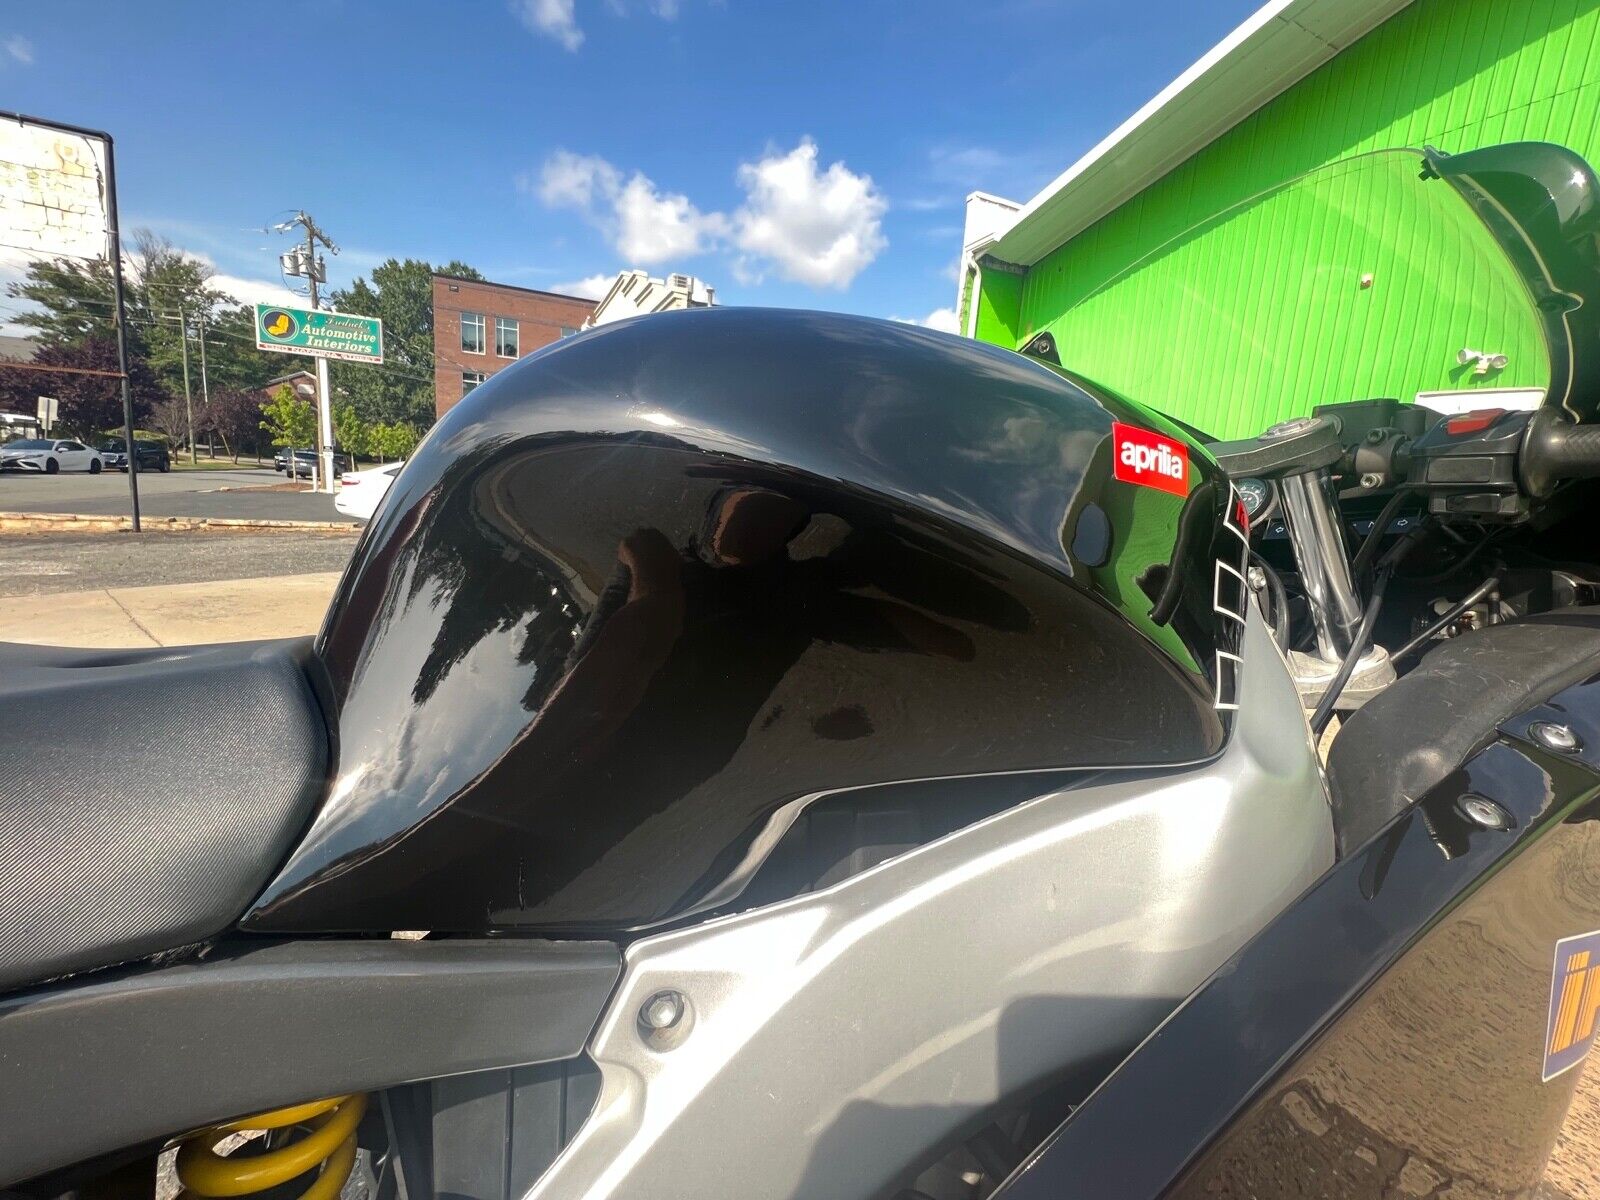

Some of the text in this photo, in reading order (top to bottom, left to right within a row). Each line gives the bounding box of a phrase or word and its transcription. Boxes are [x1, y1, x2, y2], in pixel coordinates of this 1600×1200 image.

[301, 324, 376, 343] Automotive
[306, 336, 372, 353] Interiors
[1120, 441, 1184, 480] aprilia
